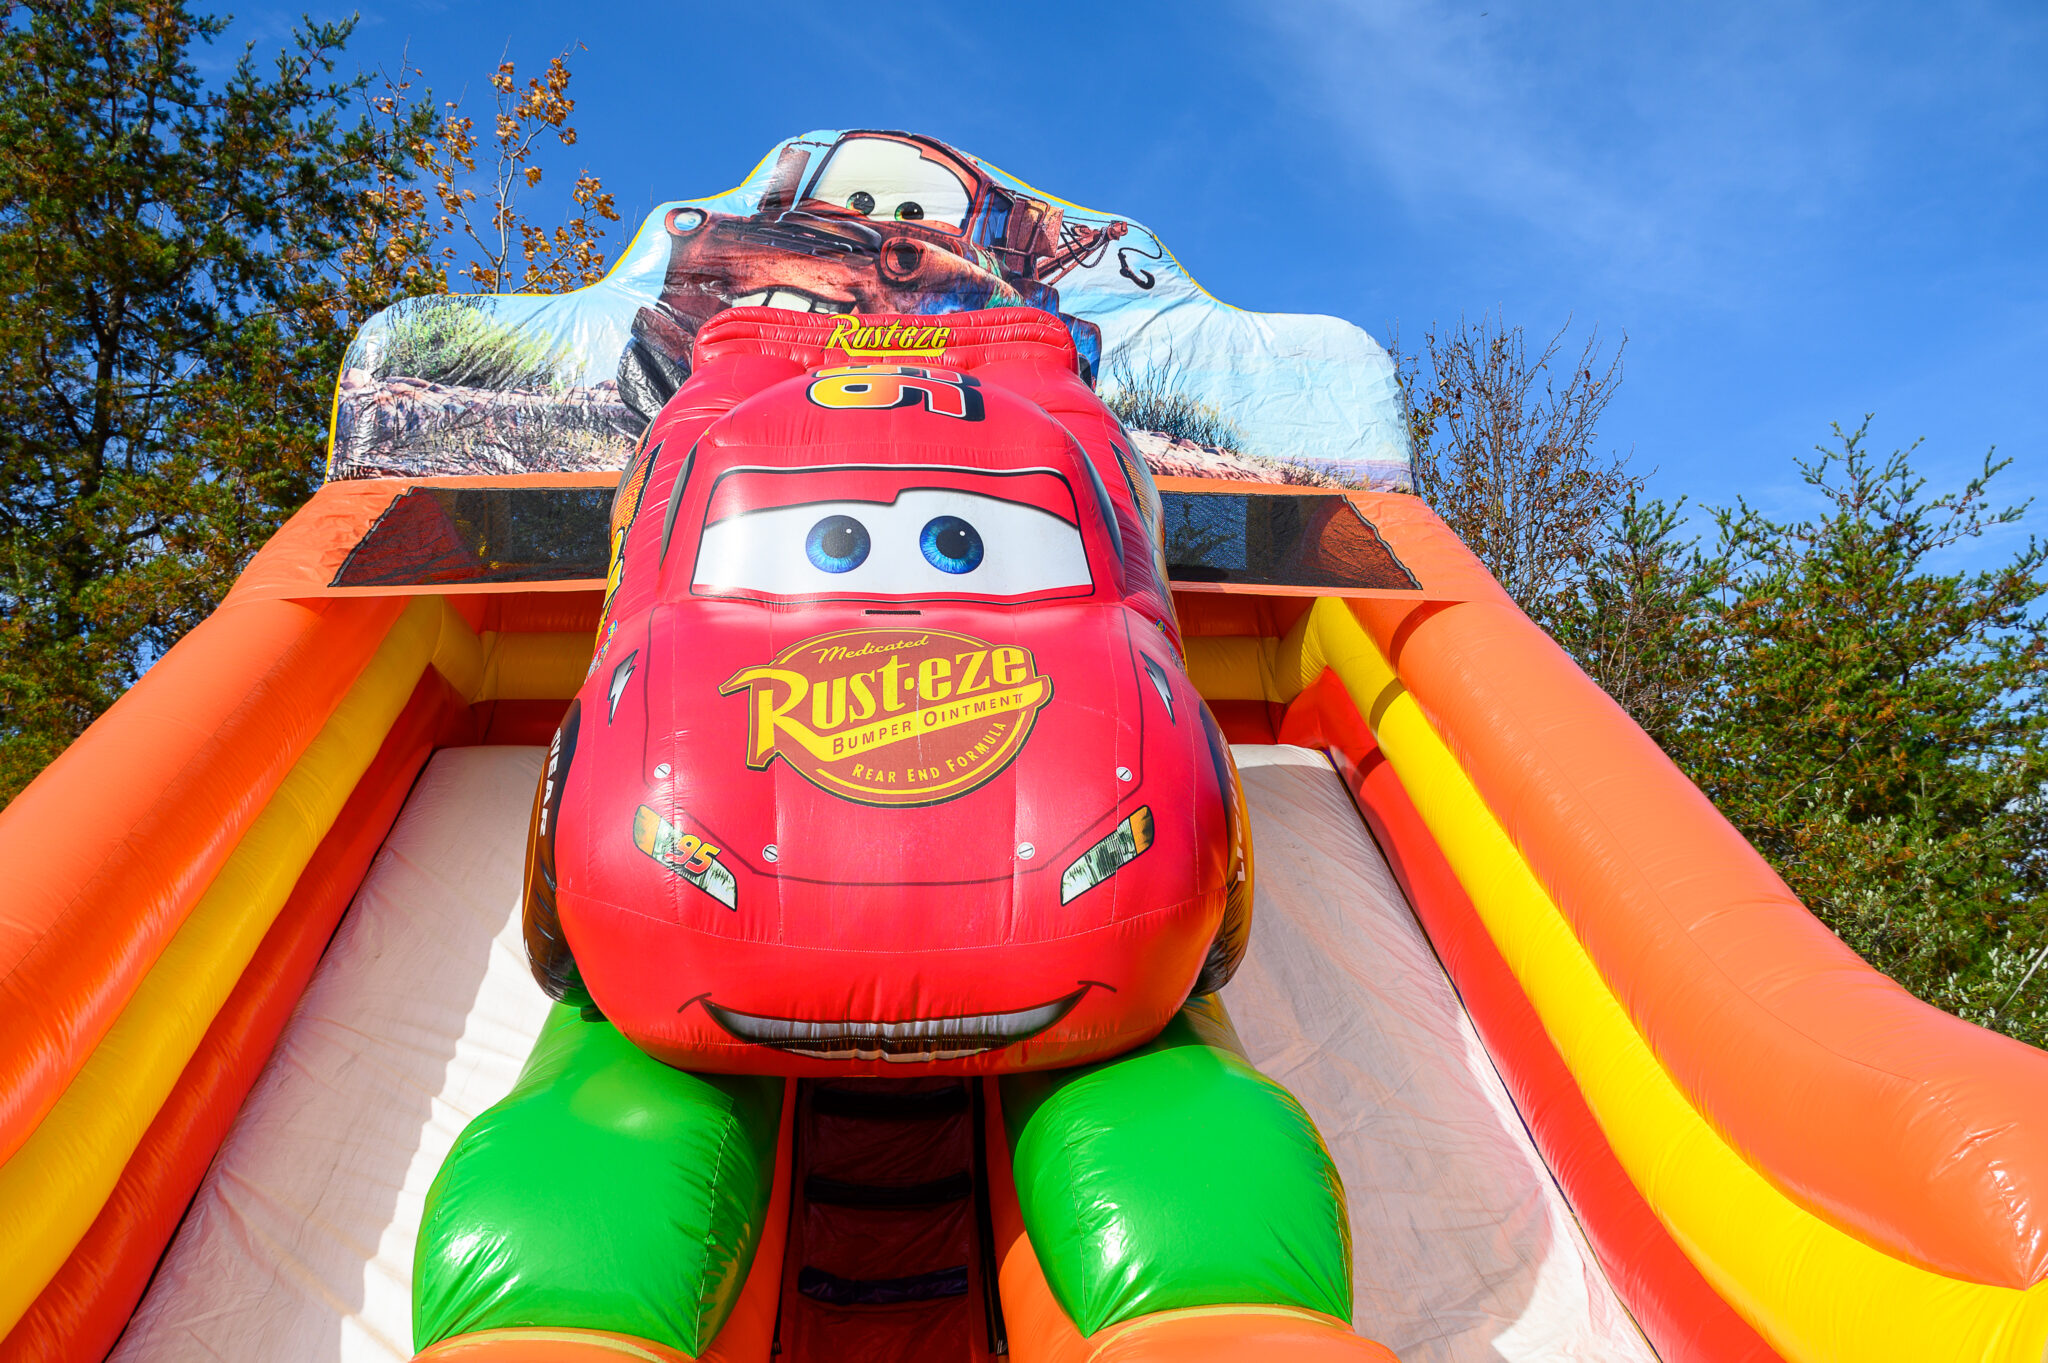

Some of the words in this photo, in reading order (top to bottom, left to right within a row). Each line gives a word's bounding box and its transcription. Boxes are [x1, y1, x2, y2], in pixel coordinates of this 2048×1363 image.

[812, 635, 929, 664] Medicated
[832, 720, 912, 755] BUMPER
[852, 763, 897, 784] REAR
[907, 767, 940, 783] END
[948, 722, 1006, 774] FORMULA
[665, 834, 722, 876] 95
